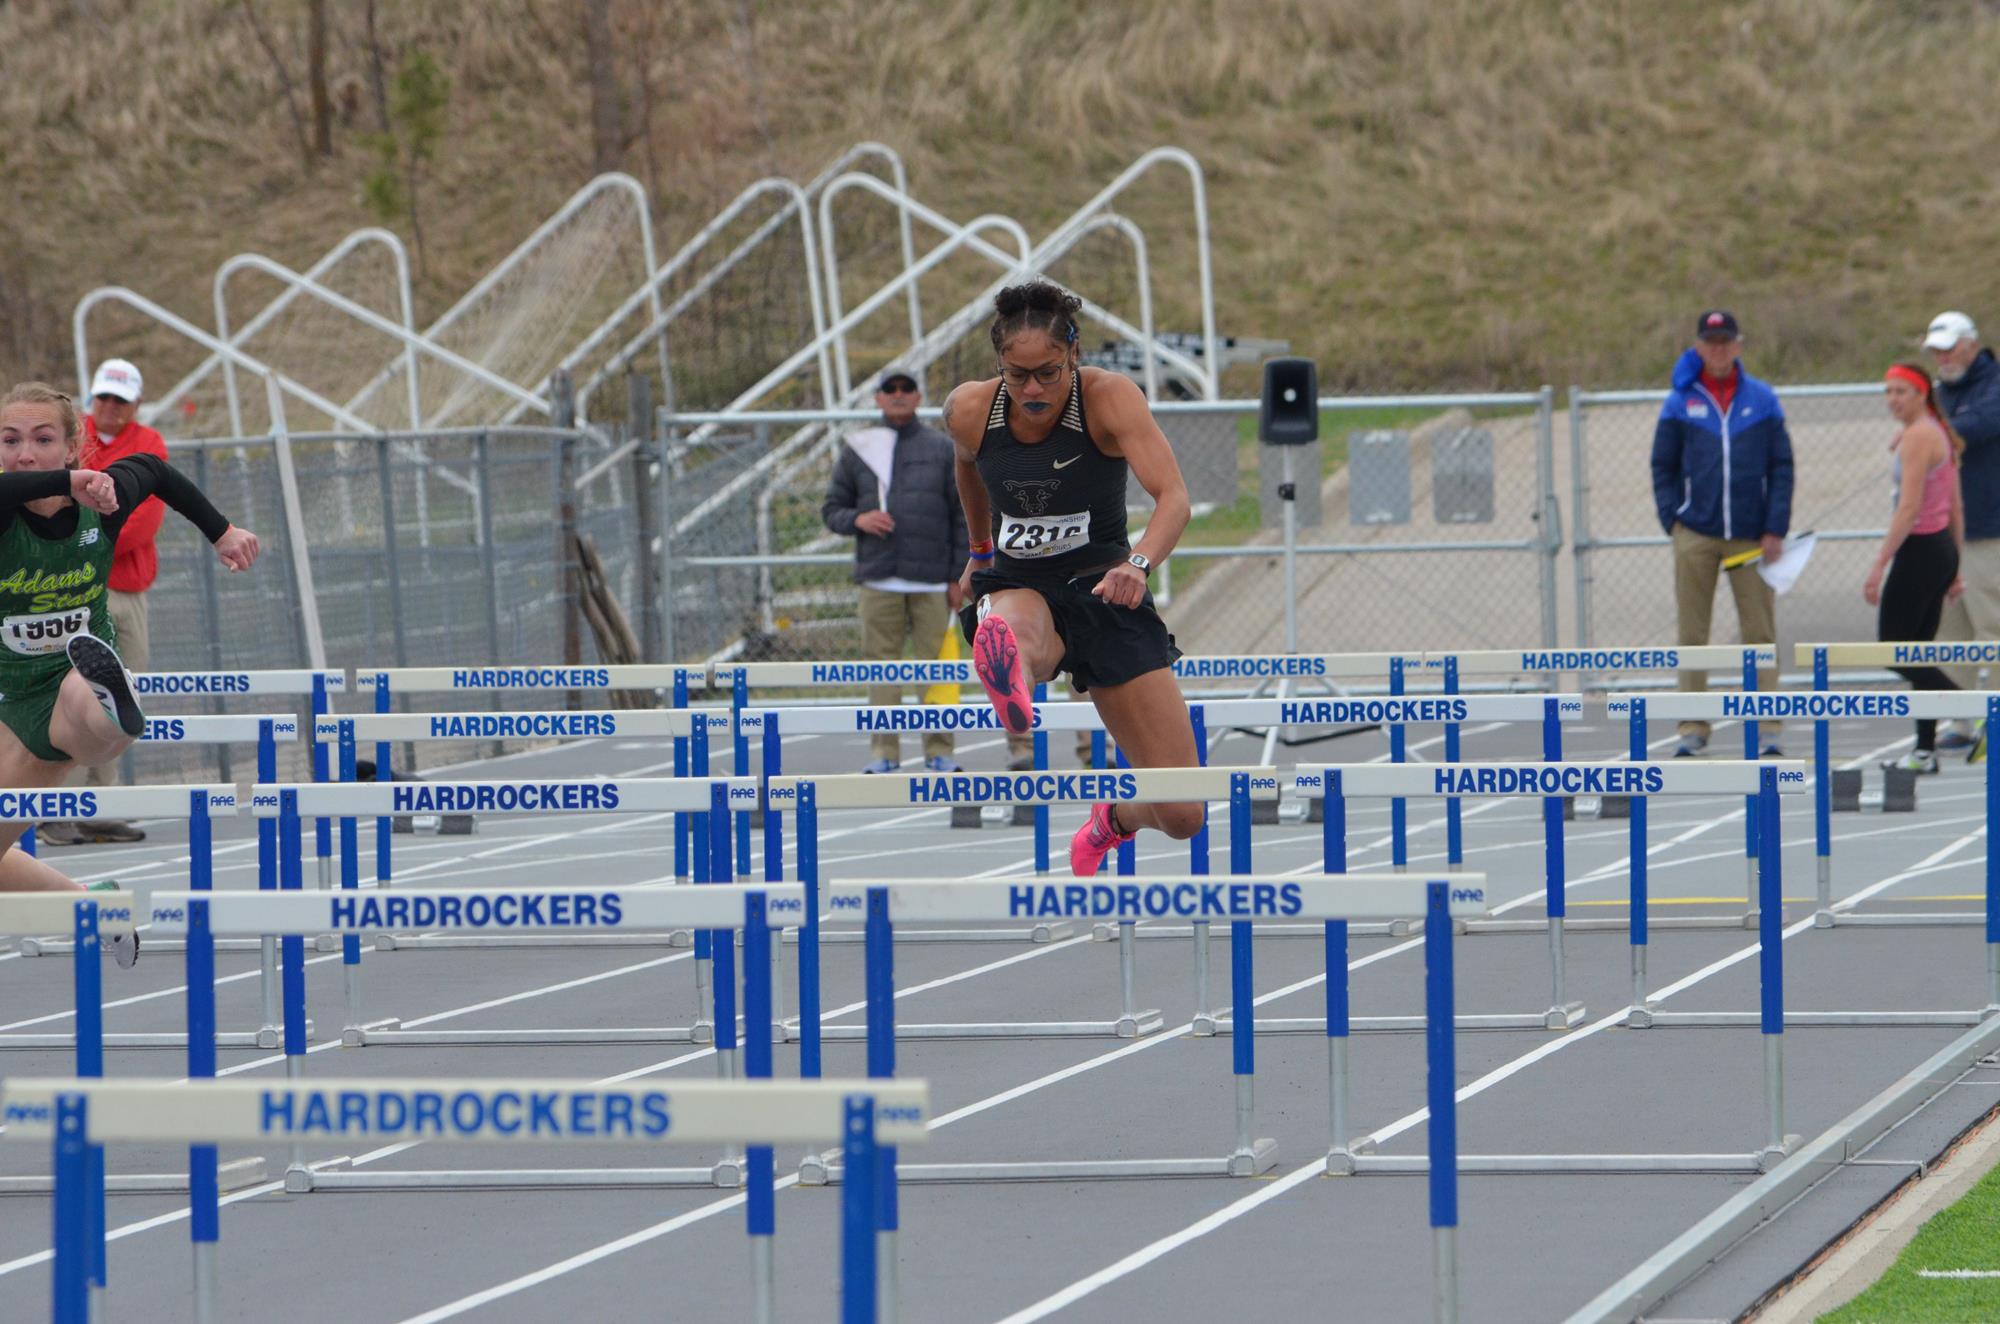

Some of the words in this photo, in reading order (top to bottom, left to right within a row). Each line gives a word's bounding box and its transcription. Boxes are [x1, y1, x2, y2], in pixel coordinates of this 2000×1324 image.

[0, 561, 96, 594] Adams
[1522, 650, 1679, 671] HARDROCKERS
[1895, 644, 2000, 662] HARDROC
[137, 675, 250, 694] DROCKERS
[453, 669, 609, 688] HARDROCKERS
[812, 663, 969, 683] HARDROCKERS
[1281, 700, 1468, 725] HARDROCKERS
[1722, 695, 1910, 717] HARDROCKERS
[430, 714, 616, 737] HARDROCKERS
[855, 707, 1042, 732] HARDROCKS
[909, 774, 1137, 803] HARDROCKERS
[1434, 767, 1664, 793] HARDROCKERS
[393, 783, 620, 811] HARDROCKERS
[330, 895, 622, 930] HARDROCKERS
[1009, 883, 1303, 917] HARDROCKERS
[260, 1090, 672, 1140] HARDROCKERS
